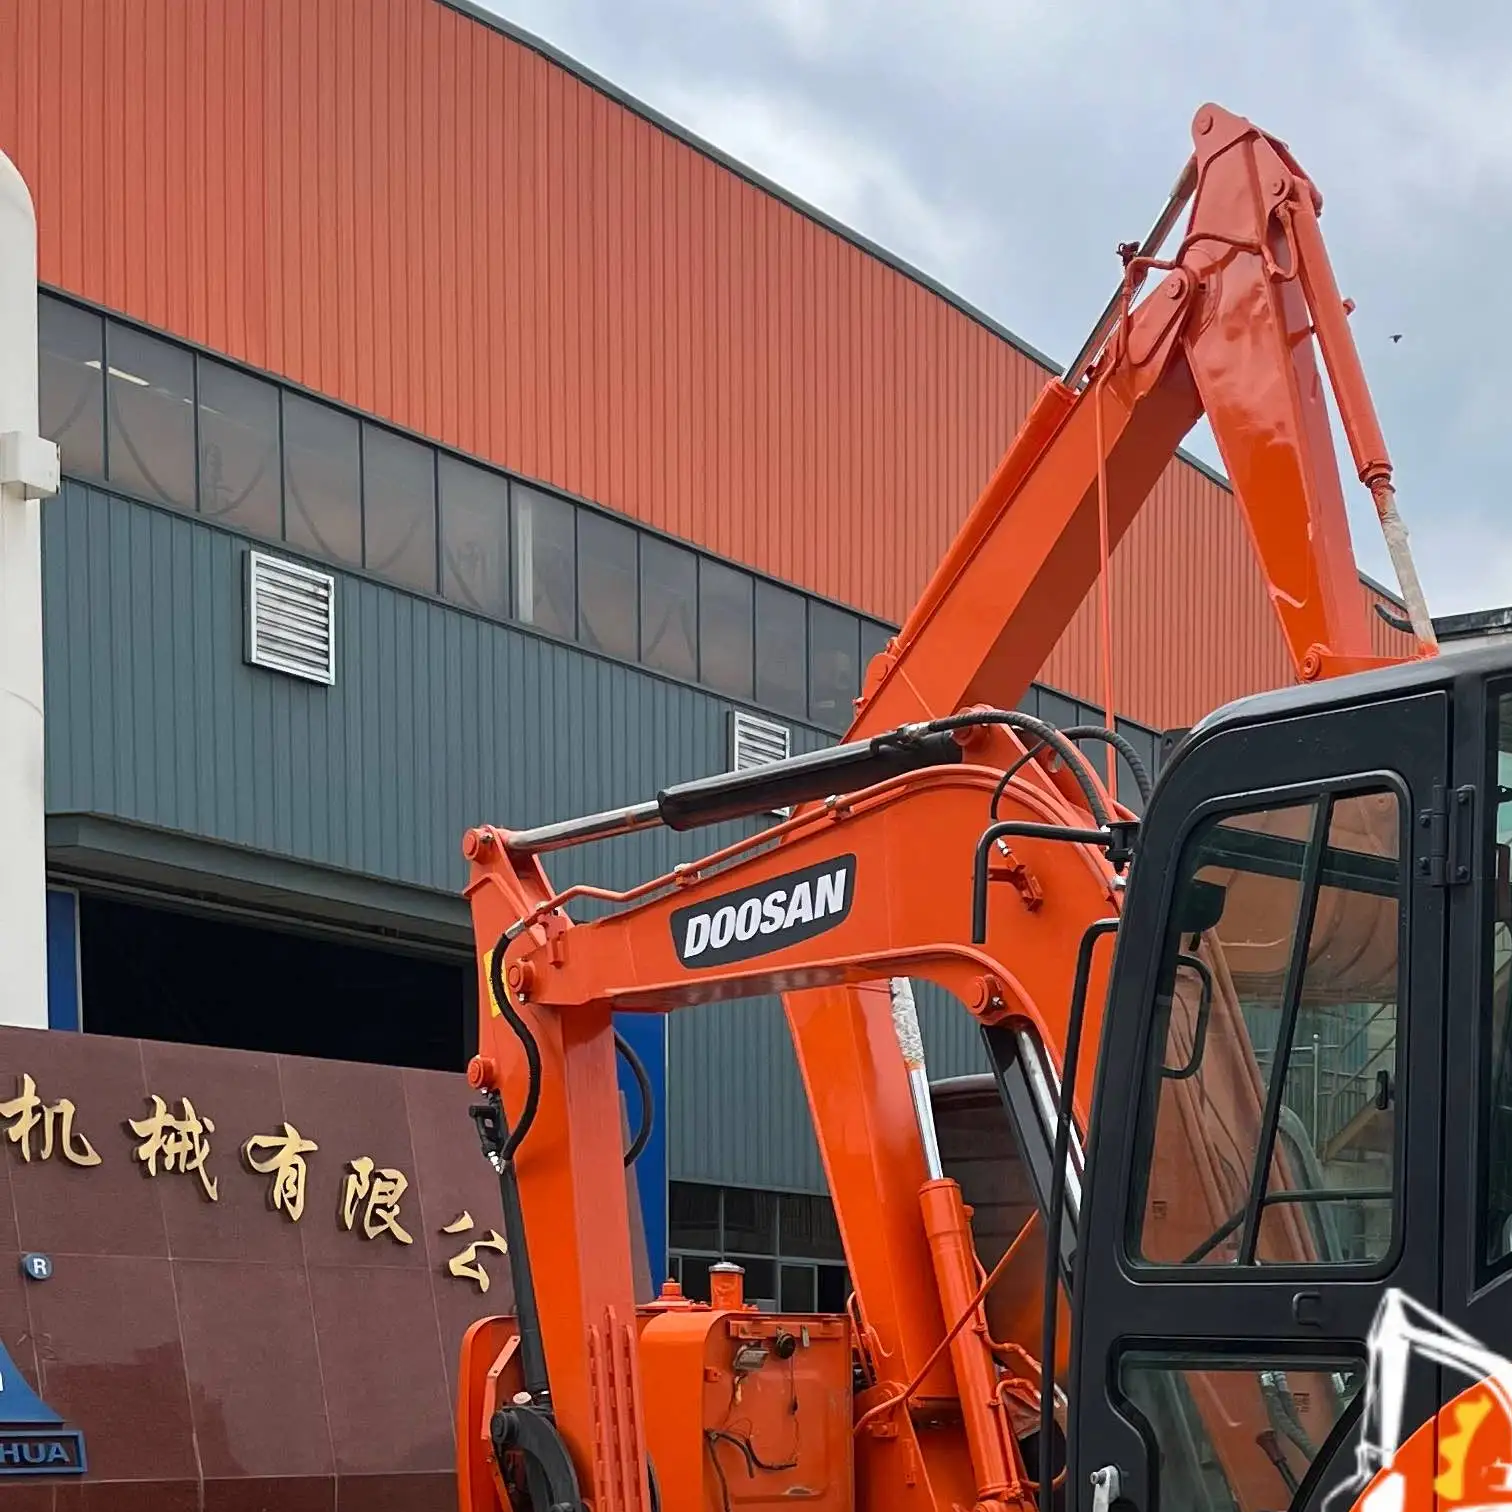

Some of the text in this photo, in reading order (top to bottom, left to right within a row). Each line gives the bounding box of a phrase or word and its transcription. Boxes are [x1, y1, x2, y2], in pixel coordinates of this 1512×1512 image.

[684, 869, 847, 958] DOOSAN
[0, 1073, 508, 1293] 机械有限公
[33, 1258, 47, 1275] R
